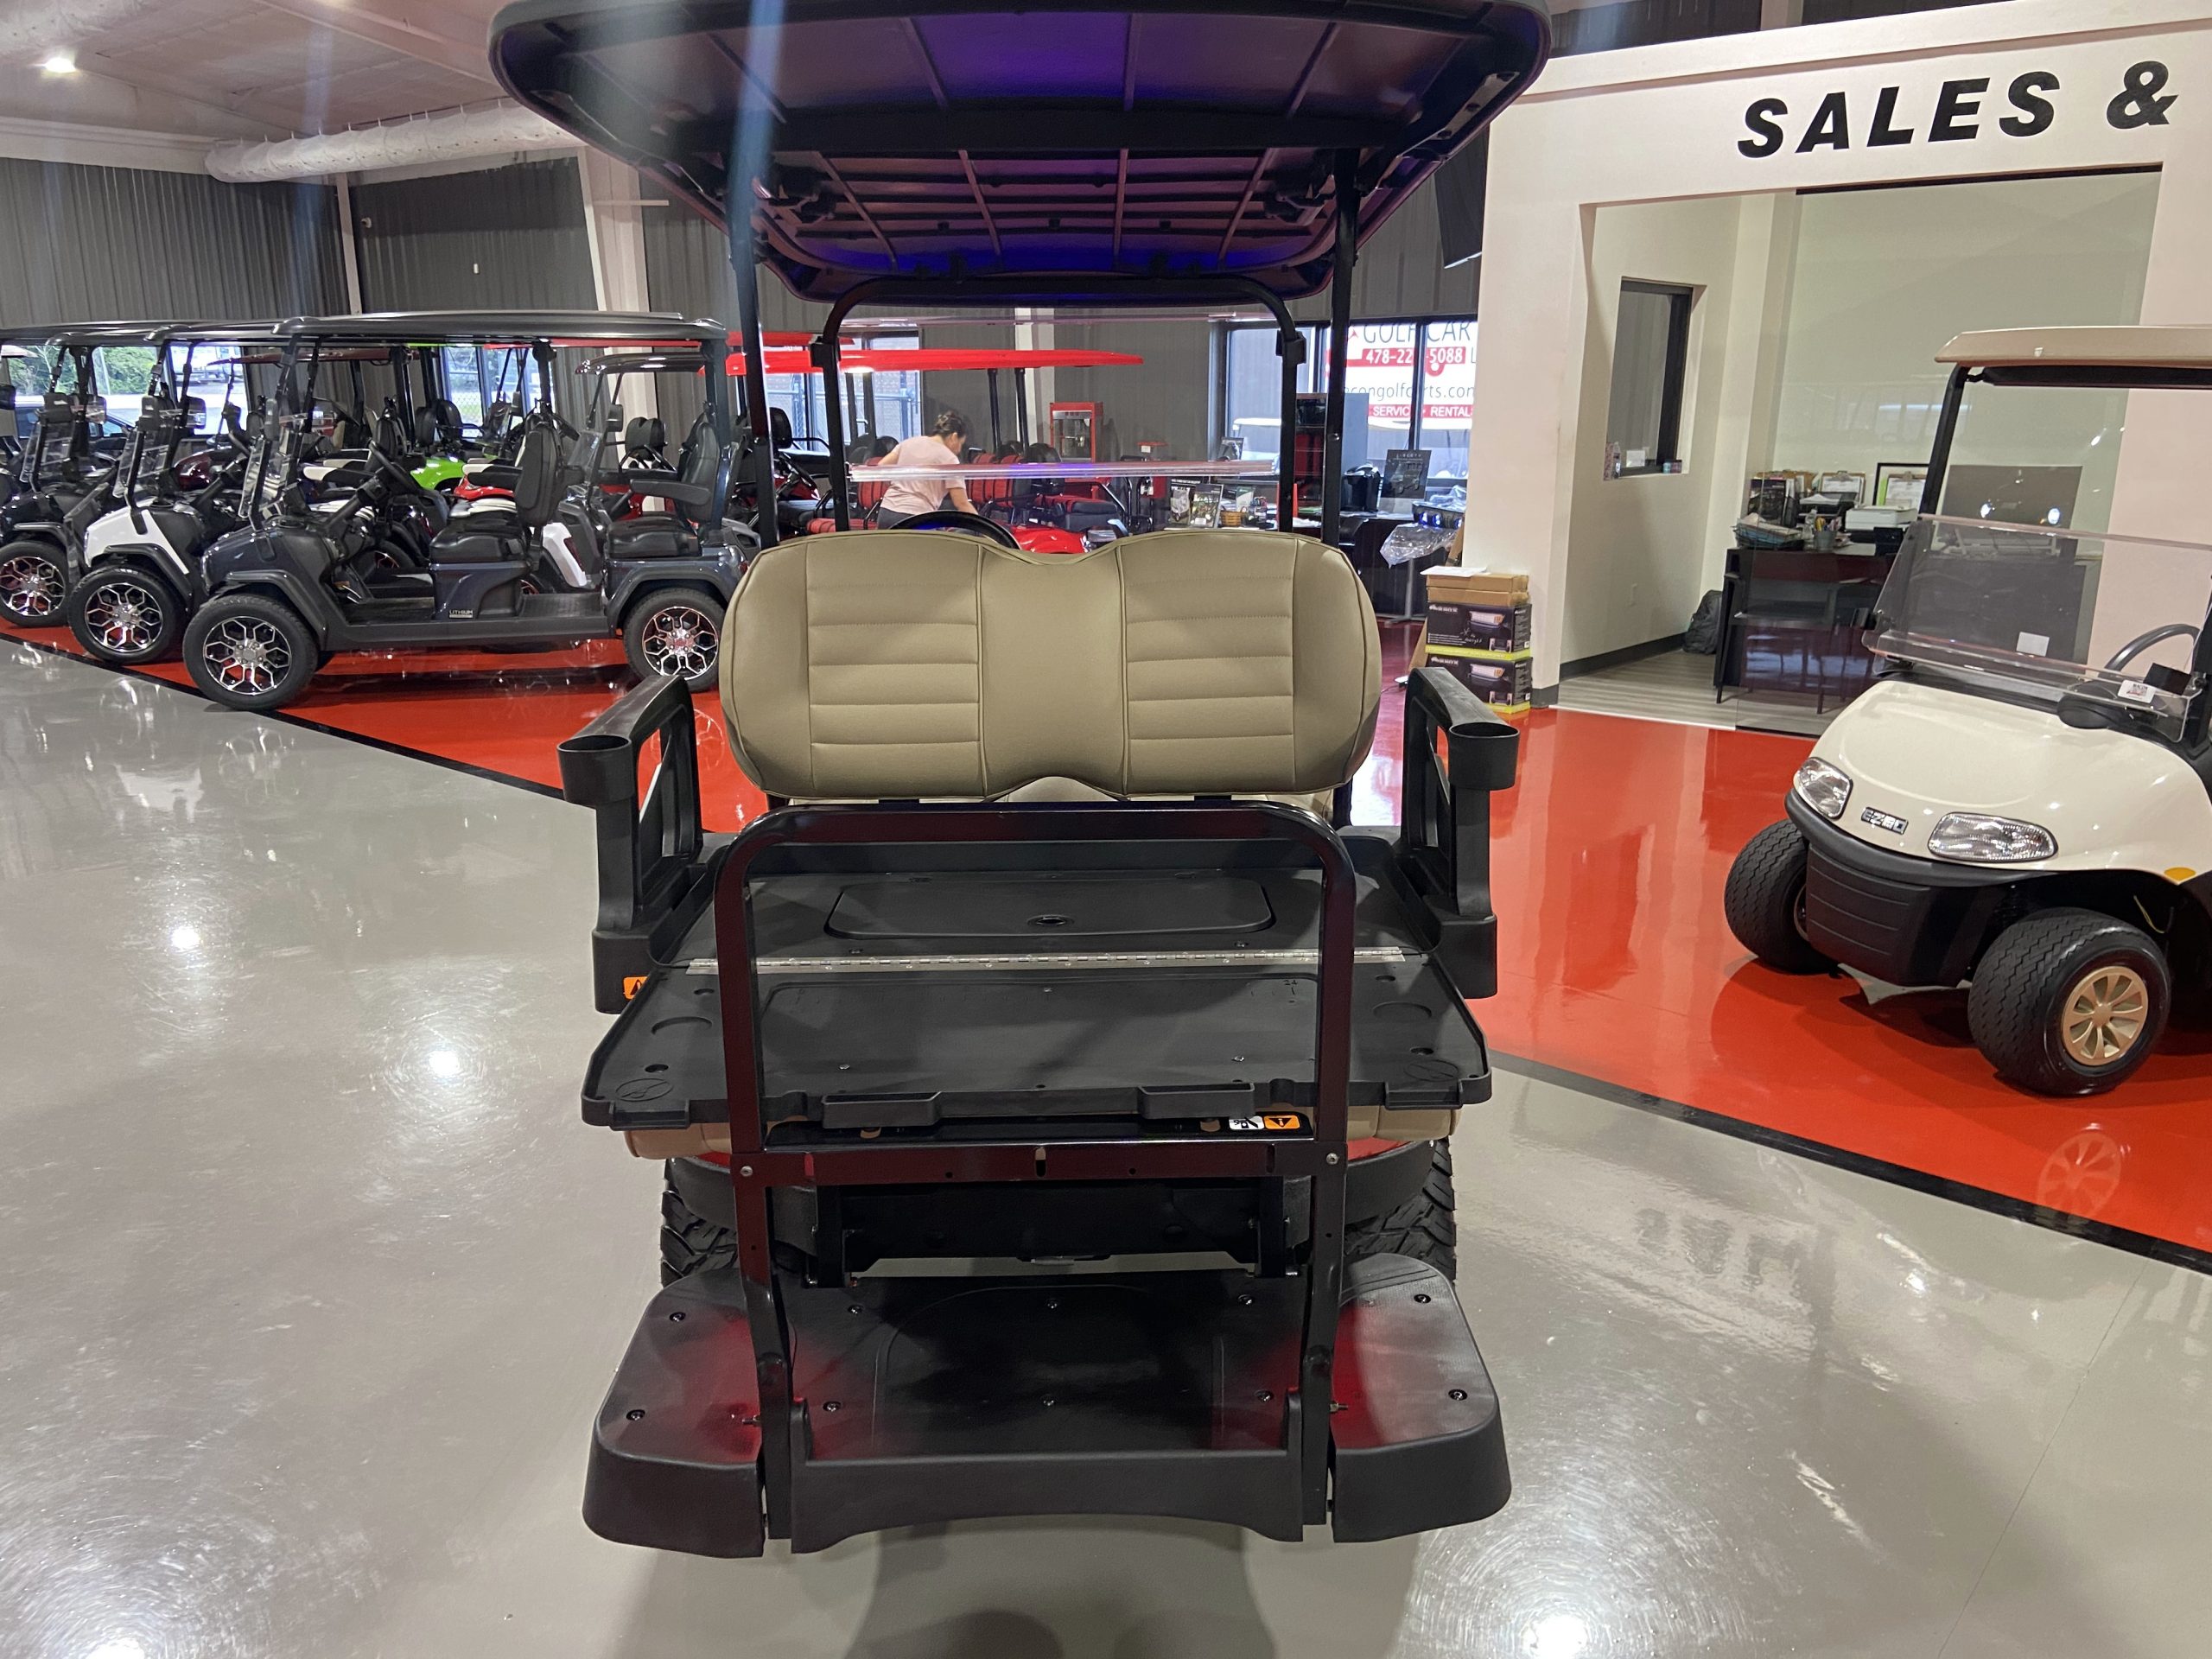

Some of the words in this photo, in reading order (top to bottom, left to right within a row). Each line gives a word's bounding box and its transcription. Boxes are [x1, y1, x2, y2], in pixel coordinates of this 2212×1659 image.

[1737, 71, 2061, 158] SALES
[2106, 60, 2178, 130] &
[1365, 347, 1464, 365] 478-22-5088
[1372, 406, 1411, 416] SERVIC
